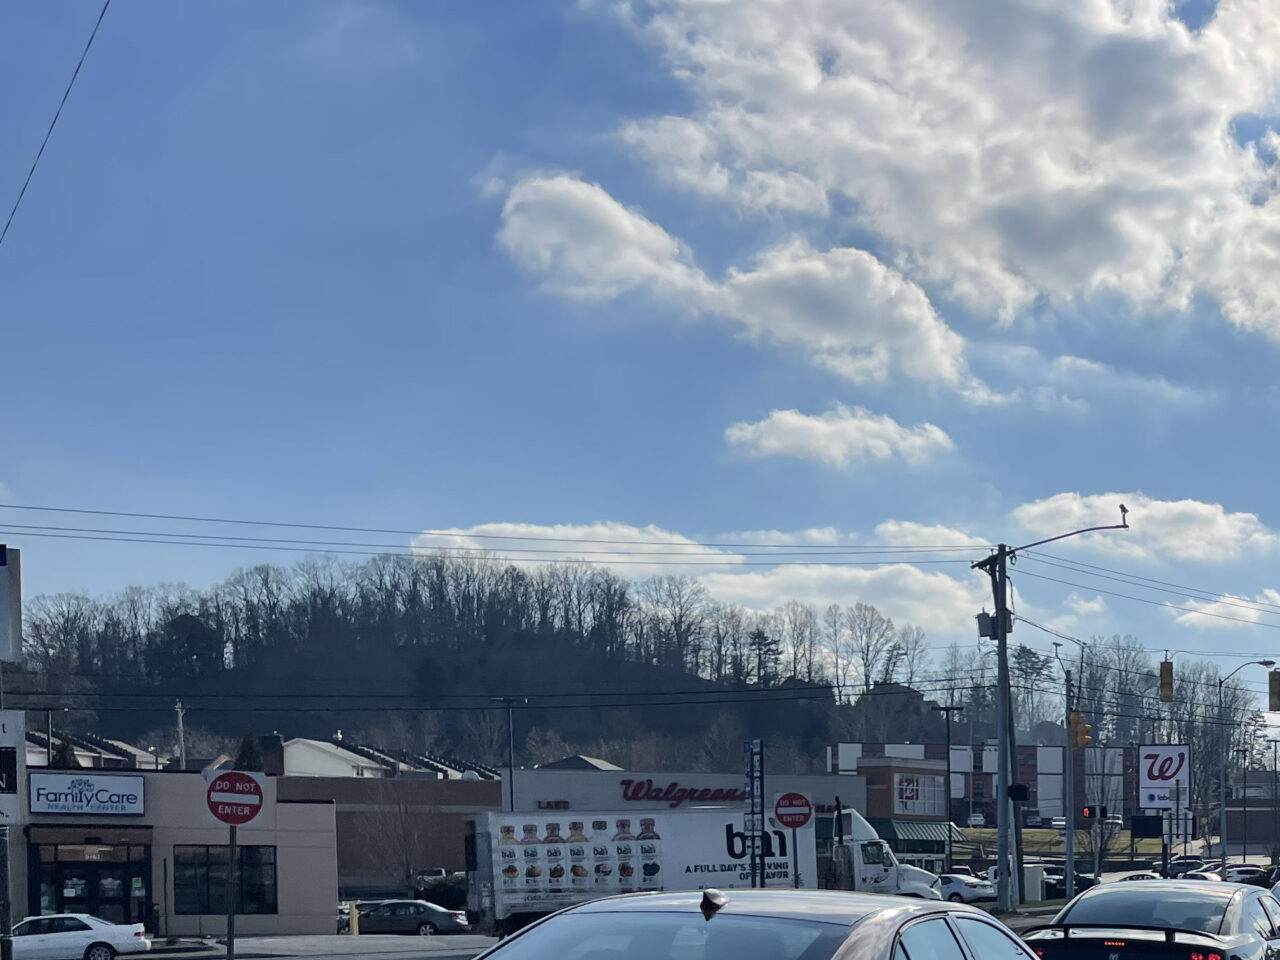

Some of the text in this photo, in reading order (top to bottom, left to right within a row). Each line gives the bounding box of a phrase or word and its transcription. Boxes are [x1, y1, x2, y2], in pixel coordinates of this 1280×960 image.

[1143, 752, 1185, 781] W
[215, 781, 256, 792] DO NOT
[218, 804, 250, 815] ENTER
[783, 815, 805, 823] ENTER
[685, 865, 692, 873] A
[694, 864, 718, 873] FULL
[720, 863, 746, 872] DAY'S
[739, 872, 752, 880] OF
